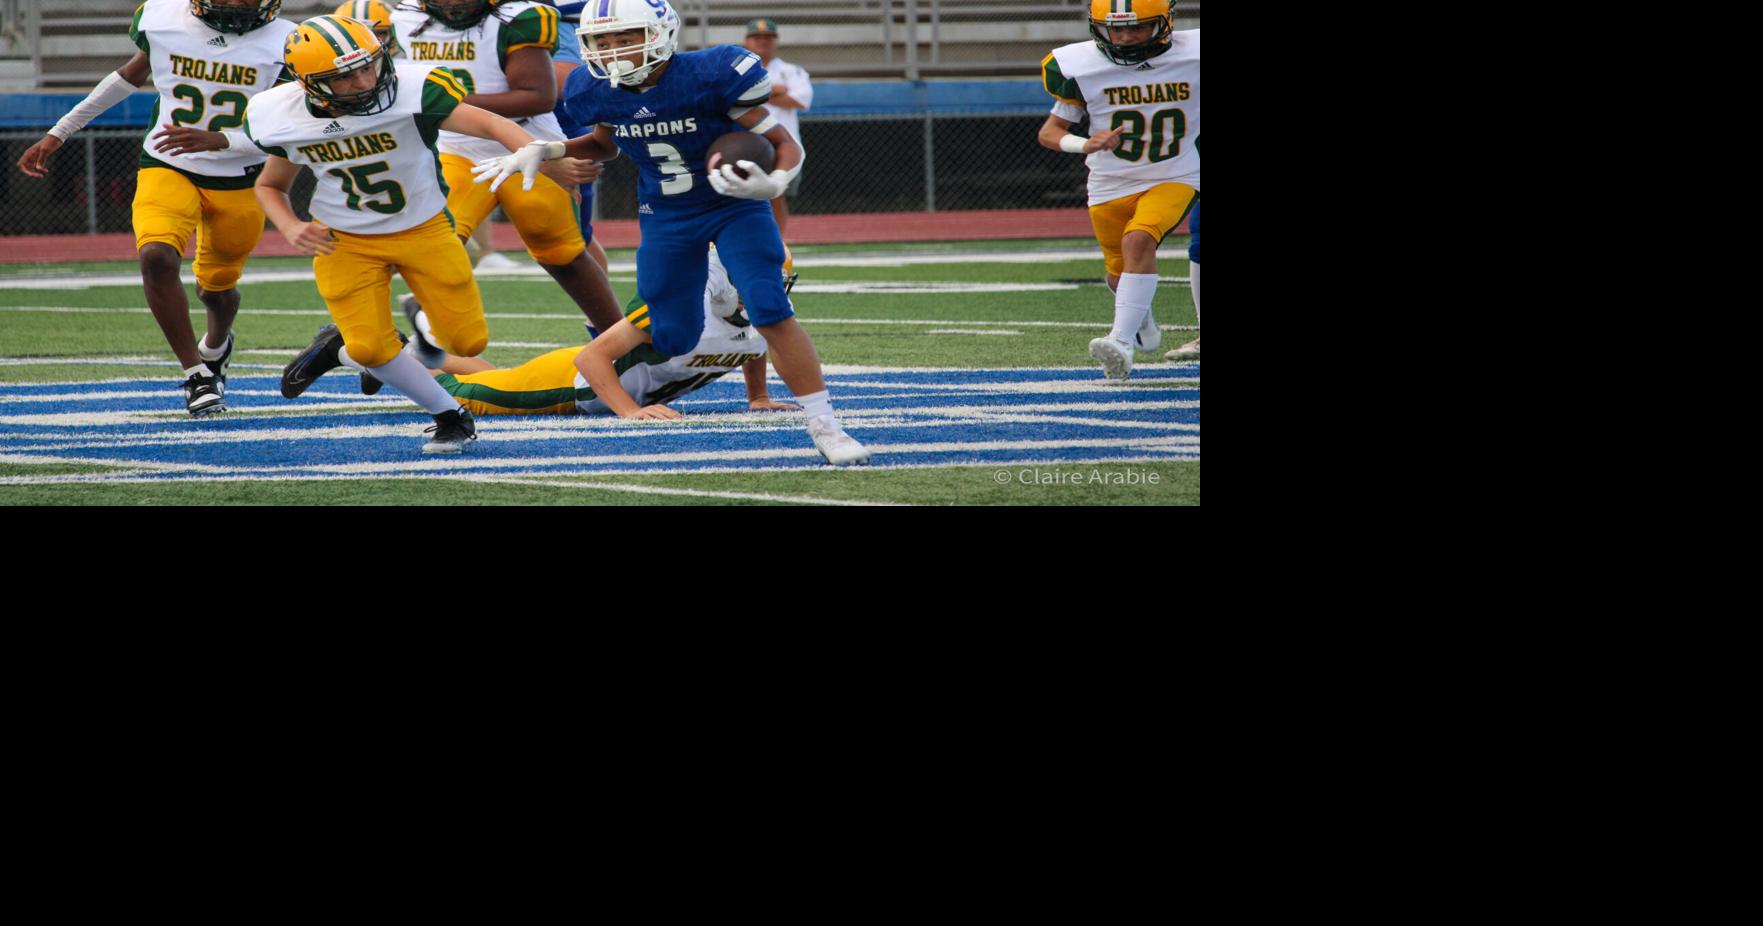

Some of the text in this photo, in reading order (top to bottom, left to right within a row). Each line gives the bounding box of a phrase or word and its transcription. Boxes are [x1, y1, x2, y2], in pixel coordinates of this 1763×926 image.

[169, 53, 258, 87] TROJANS
[410, 41, 476, 61] TROJANS
[170, 83, 249, 134] 22
[1103, 81, 1190, 106] TROJANS
[296, 131, 399, 163] TROJANS
[1110, 107, 1186, 164] 80
[326, 160, 407, 215] 15
[646, 142, 694, 196] 3
